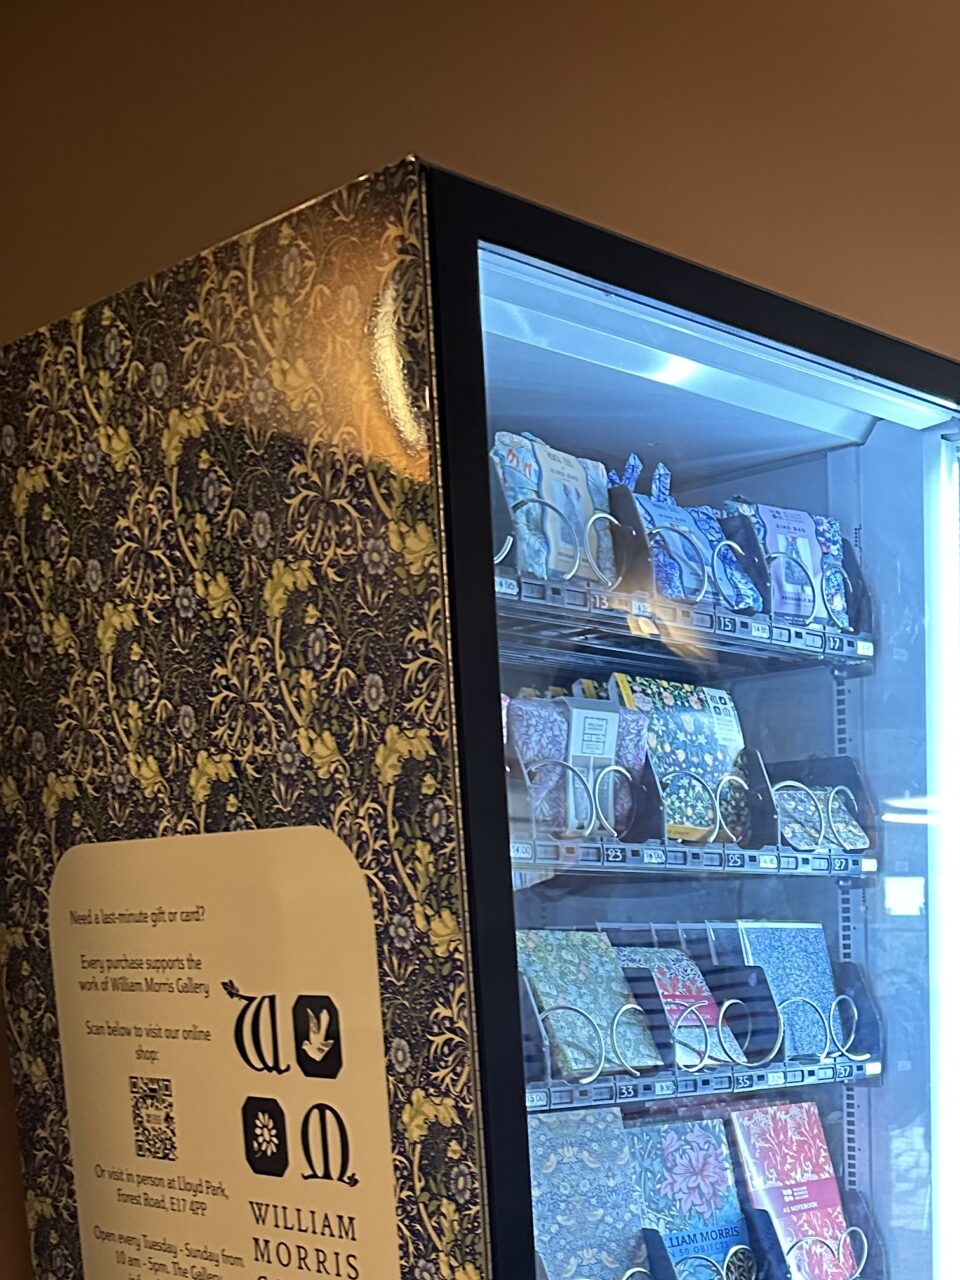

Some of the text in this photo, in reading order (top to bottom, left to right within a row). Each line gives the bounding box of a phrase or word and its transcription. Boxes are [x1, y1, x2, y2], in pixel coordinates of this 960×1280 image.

[595, 595, 609, 609] 13
[720, 617, 732, 631] 15
[829, 637, 840, 650] 17
[608, 848, 623, 862] 23
[728, 855, 741, 867] 25
[834, 859, 846, 871] 27
[70, 909, 92, 925] Need
[100, 908, 148, 925] last-minute
[150, 906, 166, 928] gift
[168, 911, 178, 922] or
[180, 905, 205, 922] card?
[80, 953, 202, 974] Every purchase supports the
[79, 976, 210, 999] work of William Morris Gallery
[85, 1020, 211, 1042] Scan below to visit our online
[135, 1044, 160, 1064] shop:
[838, 1066, 850, 1078] 37
[737, 1076, 750, 1088] 35
[620, 1086, 635, 1098] 33
[94, 1163, 229, 1200] Or visit in person at Lloyd Park,
[116, 1188, 208, 1216] Forest Road, E17 4PP
[790, 1201, 819, 1212] NOTEBOOK
[249, 1200, 357, 1241] WILLIAM
[699, 1226, 740, 1243] MORRIS
[93, 1225, 117, 1244] Open
[118, 1234, 141, 1251] every
[141, 1234, 178, 1259] Tuesday
[184, 1242, 220, 1267] Sunday
[221, 1248, 245, 1268] from
[680, 1248, 690, 1257] 50
[693, 1241, 730, 1254] OBJECTS
[115, 1250, 127, 1265] 10
[127, 1256, 142, 1268] am
[171, 1261, 189, 1279] The
[252, 1237, 360, 1280] MORRIS
